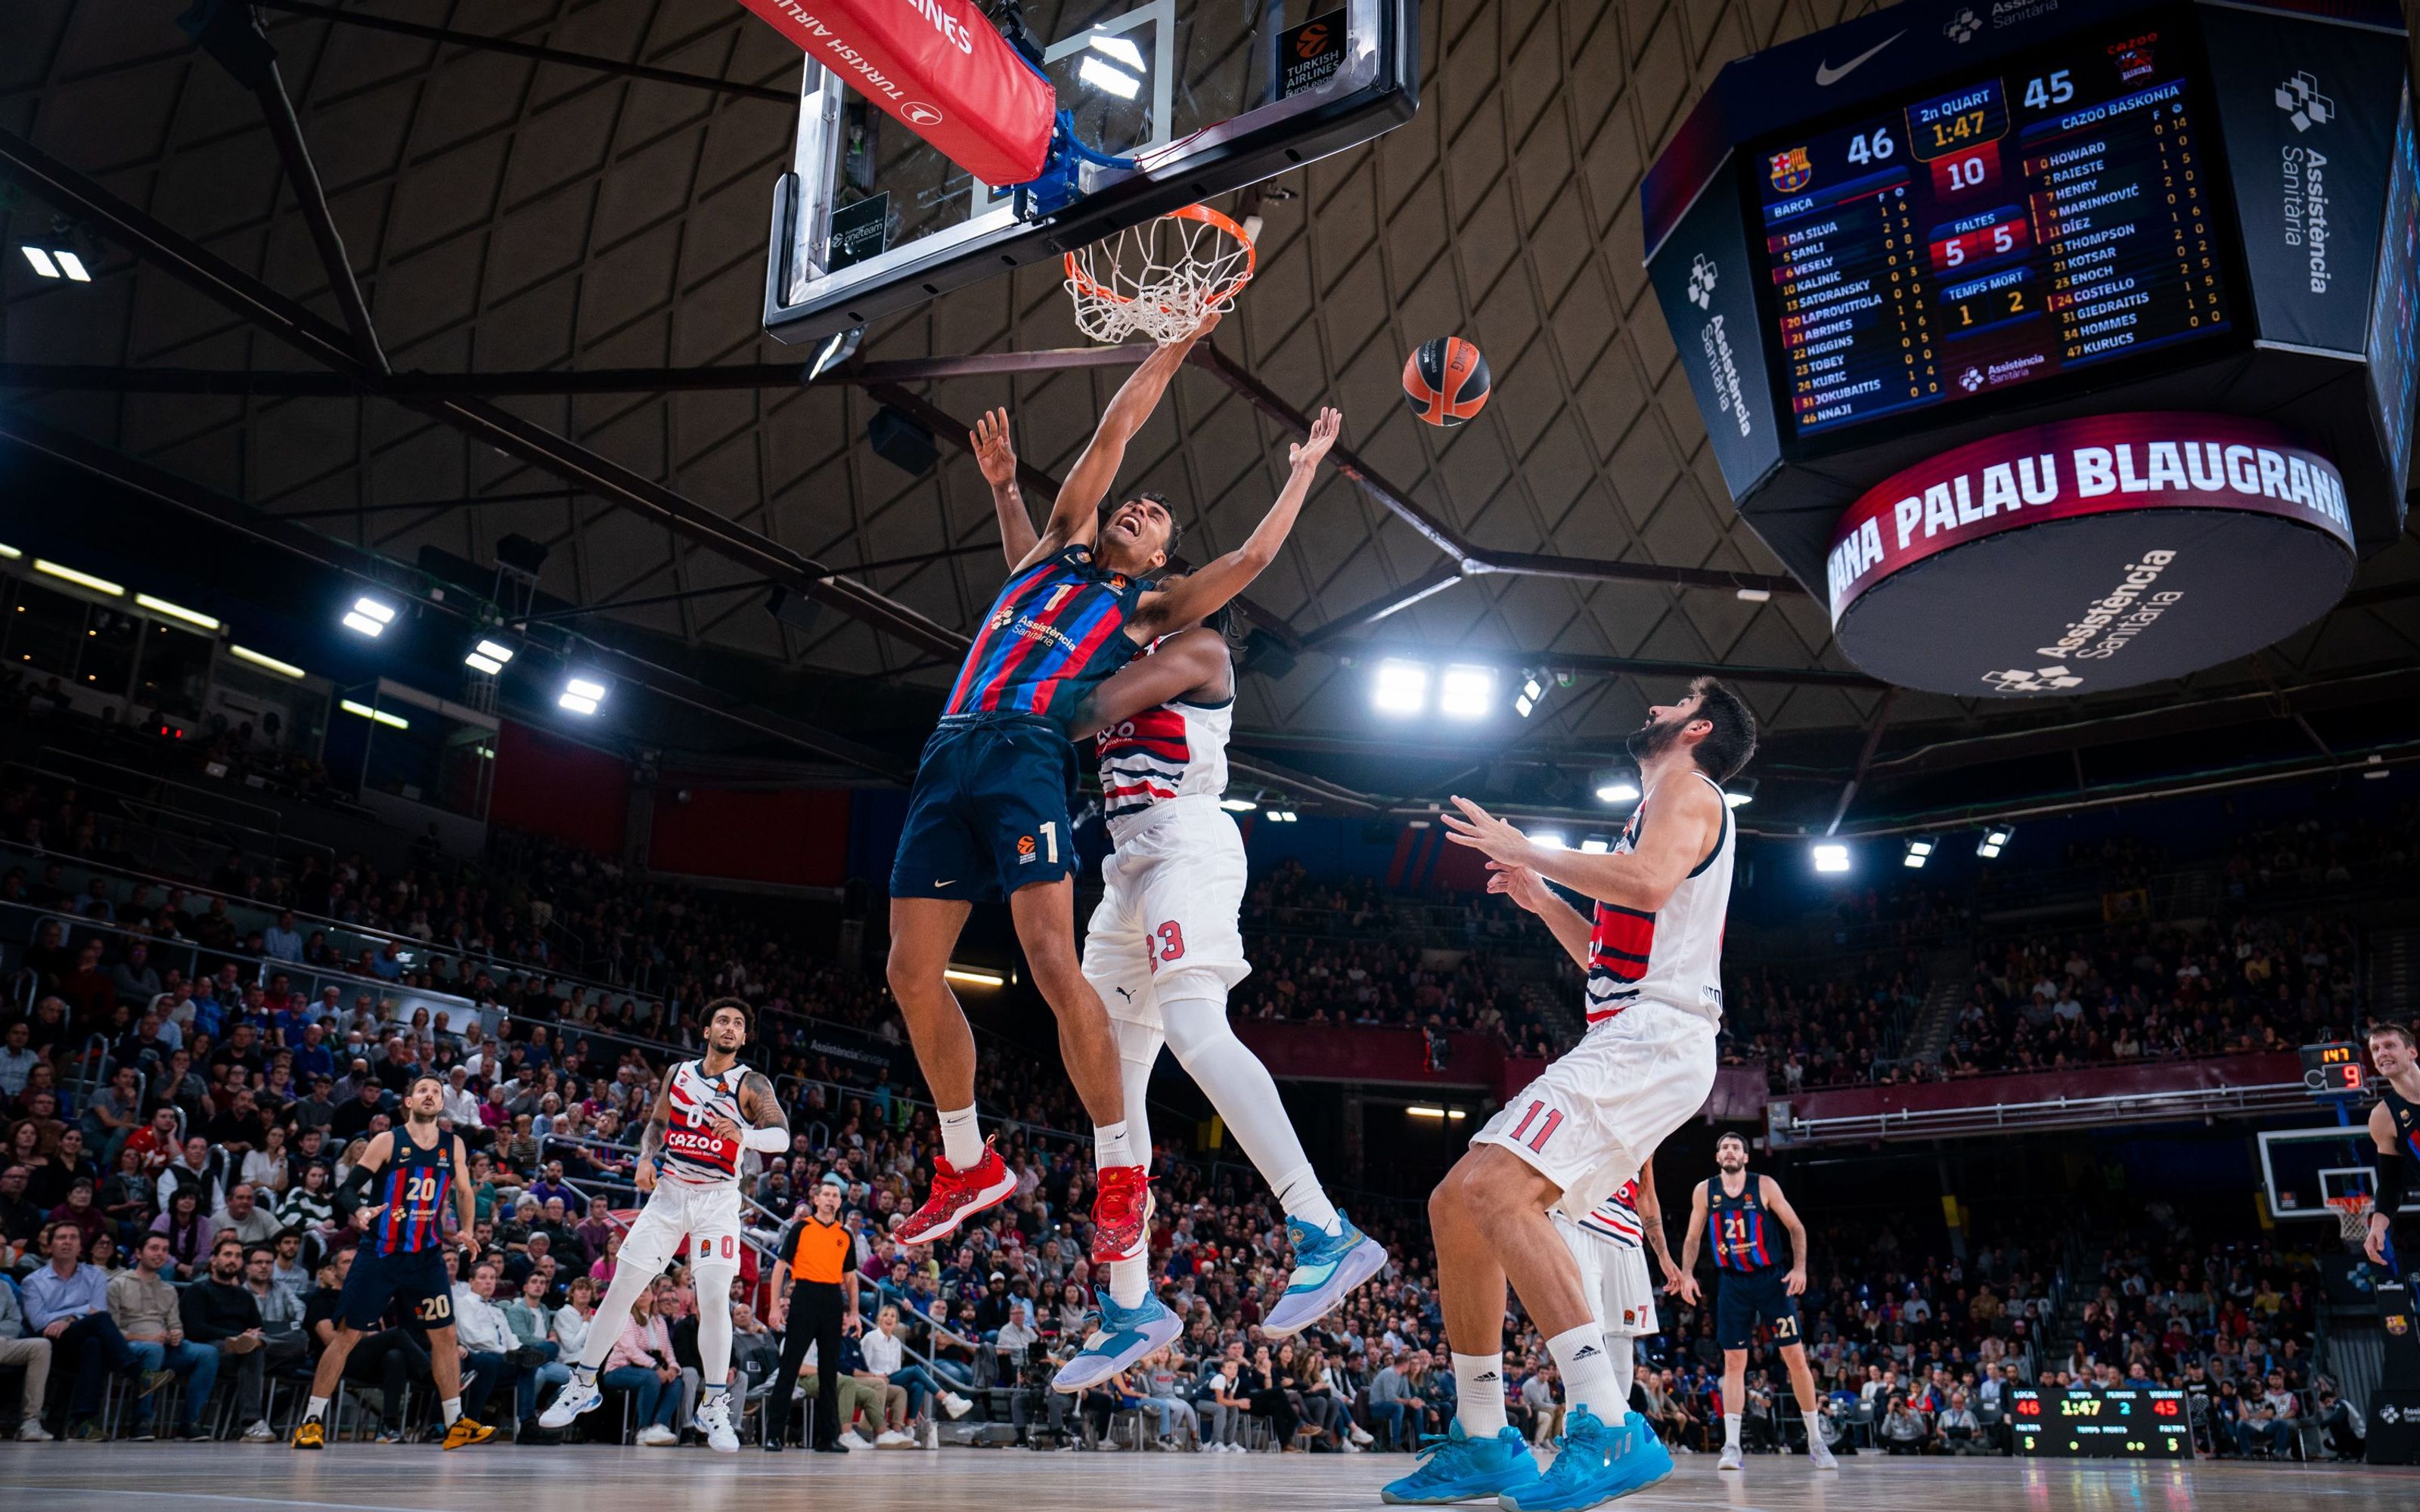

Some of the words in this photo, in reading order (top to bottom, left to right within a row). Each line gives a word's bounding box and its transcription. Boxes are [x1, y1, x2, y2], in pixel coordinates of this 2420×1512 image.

[827, 39, 904, 100] TURKISH
[1286, 60, 1339, 88] AIRLINES
[1287, 50, 1339, 77] TURKISH
[1941, 89, 1990, 116] QUART
[2024, 69, 2074, 110] 45
[2062, 107, 2105, 130] CAZOO
[2108, 85, 2180, 116] BASKONIA
[1848, 128, 1894, 165] 46
[1932, 110, 1984, 147] 1:47
[2040, 158, 2048, 169] 0
[2049, 141, 2105, 166] HOWARD
[2155, 125, 2162, 135] 0
[2173, 117, 2187, 130] 14
[1947, 157, 1985, 191] 10
[2044, 175, 2051, 186] 2
[2052, 160, 2105, 183] RAIESTE
[2159, 142, 2165, 152] 1
[2179, 136, 2187, 146] 0
[2046, 192, 2054, 202] 7
[2055, 179, 2097, 200] HENRY
[2182, 153, 2190, 163] 5
[1774, 198, 1813, 218] BARÇA
[2049, 209, 2057, 219] 9
[2185, 170, 2194, 181] 0
[2049, 226, 2061, 237] 11
[2189, 187, 2197, 198] 3
[2282, 145, 2307, 246] Sanitària
[844, 223, 883, 243] oneteam
[1782, 236, 1789, 246] 1
[1789, 233, 1805, 245] DA
[1806, 222, 1838, 240] SILVA
[1882, 206, 1888, 217] 1
[1899, 201, 1907, 211] 6
[1783, 252, 1791, 262] 5
[1901, 218, 1910, 228] 3
[1955, 213, 1996, 234] FALTES
[2051, 243, 2064, 255] 13
[2065, 224, 2136, 251] THOMPSON
[2192, 206, 2201, 216] 6
[2306, 147, 2332, 294] Assistència
[1786, 268, 1794, 278] 6
[1793, 256, 1834, 275] VESELY
[1904, 234, 1912, 244] 8
[1945, 239, 1965, 266] 5
[1993, 225, 2013, 253] 5
[2053, 261, 2066, 272] 21
[2068, 247, 2117, 268] KOTSAR
[2195, 223, 2204, 234] 0
[2055, 277, 2070, 290] 23
[2071, 265, 2114, 285] ENOCH
[2198, 240, 2207, 250] 2
[1783, 285, 1795, 296] 10
[1796, 271, 1841, 292] KALINIC
[1907, 250, 1914, 260] 7
[1786, 300, 1798, 311] 13
[1798, 280, 1870, 308] SATORANSKY
[1910, 267, 1917, 277] 3
[1948, 282, 1987, 300] TEMPS
[1990, 271, 2023, 290] MORT
[2058, 294, 2072, 307] 24
[2074, 277, 2135, 302] COSTELLO
[2201, 258, 2210, 268] 5
[1787, 317, 1801, 328] 20
[1801, 294, 1883, 324] LAPROVITTOLA
[1913, 284, 1920, 293] 0
[1959, 305, 1973, 326] 1
[2008, 291, 2024, 312] 2
[2062, 311, 2076, 324] 31
[2077, 292, 2149, 320] GIEDRAITIS
[2205, 275, 2214, 286] 5
[2063, 329, 2079, 341] 34
[2080, 313, 2138, 336] HOMMES
[2208, 293, 2217, 303] 5
[1792, 333, 1804, 344] 21
[1804, 319, 1853, 340] ABRINES
[1916, 300, 1923, 310] 4
[1793, 348, 1807, 360] 22
[1807, 336, 1854, 357] HIGGINS
[1919, 316, 1926, 326] 6
[2067, 345, 2081, 358] 47
[2083, 332, 2134, 354] KURUCS
[2211, 311, 2220, 321] 0
[1701, 323, 1730, 412] Sanitària
[1711, 314, 1751, 437] Assistència
[1795, 364, 1809, 376] 23
[1809, 355, 1844, 372] TOBEY
[1921, 333, 1928, 342] 5
[1797, 380, 1811, 392] 24
[1812, 371, 1847, 389] KURIC
[1924, 349, 1931, 359] 0
[1987, 353, 2045, 375] Assistència
[1801, 397, 1813, 407] 31
[1815, 380, 1882, 404] JOKUBAITIS
[1927, 365, 1934, 375] 4
[1802, 413, 1817, 424] 46
[1817, 404, 1852, 420] NNAJI
[1929, 383, 1938, 392] 0
[1894, 454, 2059, 550] PALAU
[1044, 584, 1073, 611] 1
[2036, 550, 2177, 658] Assistència
[1012, 624, 1054, 647] Sanitària
[1017, 615, 1076, 652] Assistència
[2075, 591, 2184, 659] Sanitària
[1039, 821, 1058, 863] 1
[1146, 919, 1185, 976] 23
[2343, 1064, 2360, 1089] 9
[687, 1105, 703, 1128] 0
[1509, 1099, 1565, 1154] 11
[669, 1133, 723, 1152] CAZOO
[406, 1177, 436, 1201] 20
[721, 1235, 734, 1259] 0
[1725, 1218, 1746, 1238] 21
[422, 1294, 451, 1321] 20
[1638, 1306, 1648, 1328] 7
[1776, 1315, 1798, 1338] 21
[2016, 1399, 2040, 1415] 46
[2061, 1399, 2102, 1416] 1:47
[2120, 1402, 2130, 1415] 2
[2153, 1399, 2178, 1416] 45
[2024, 1436, 2035, 1450] 5
[2167, 1437, 2178, 1452] 5
